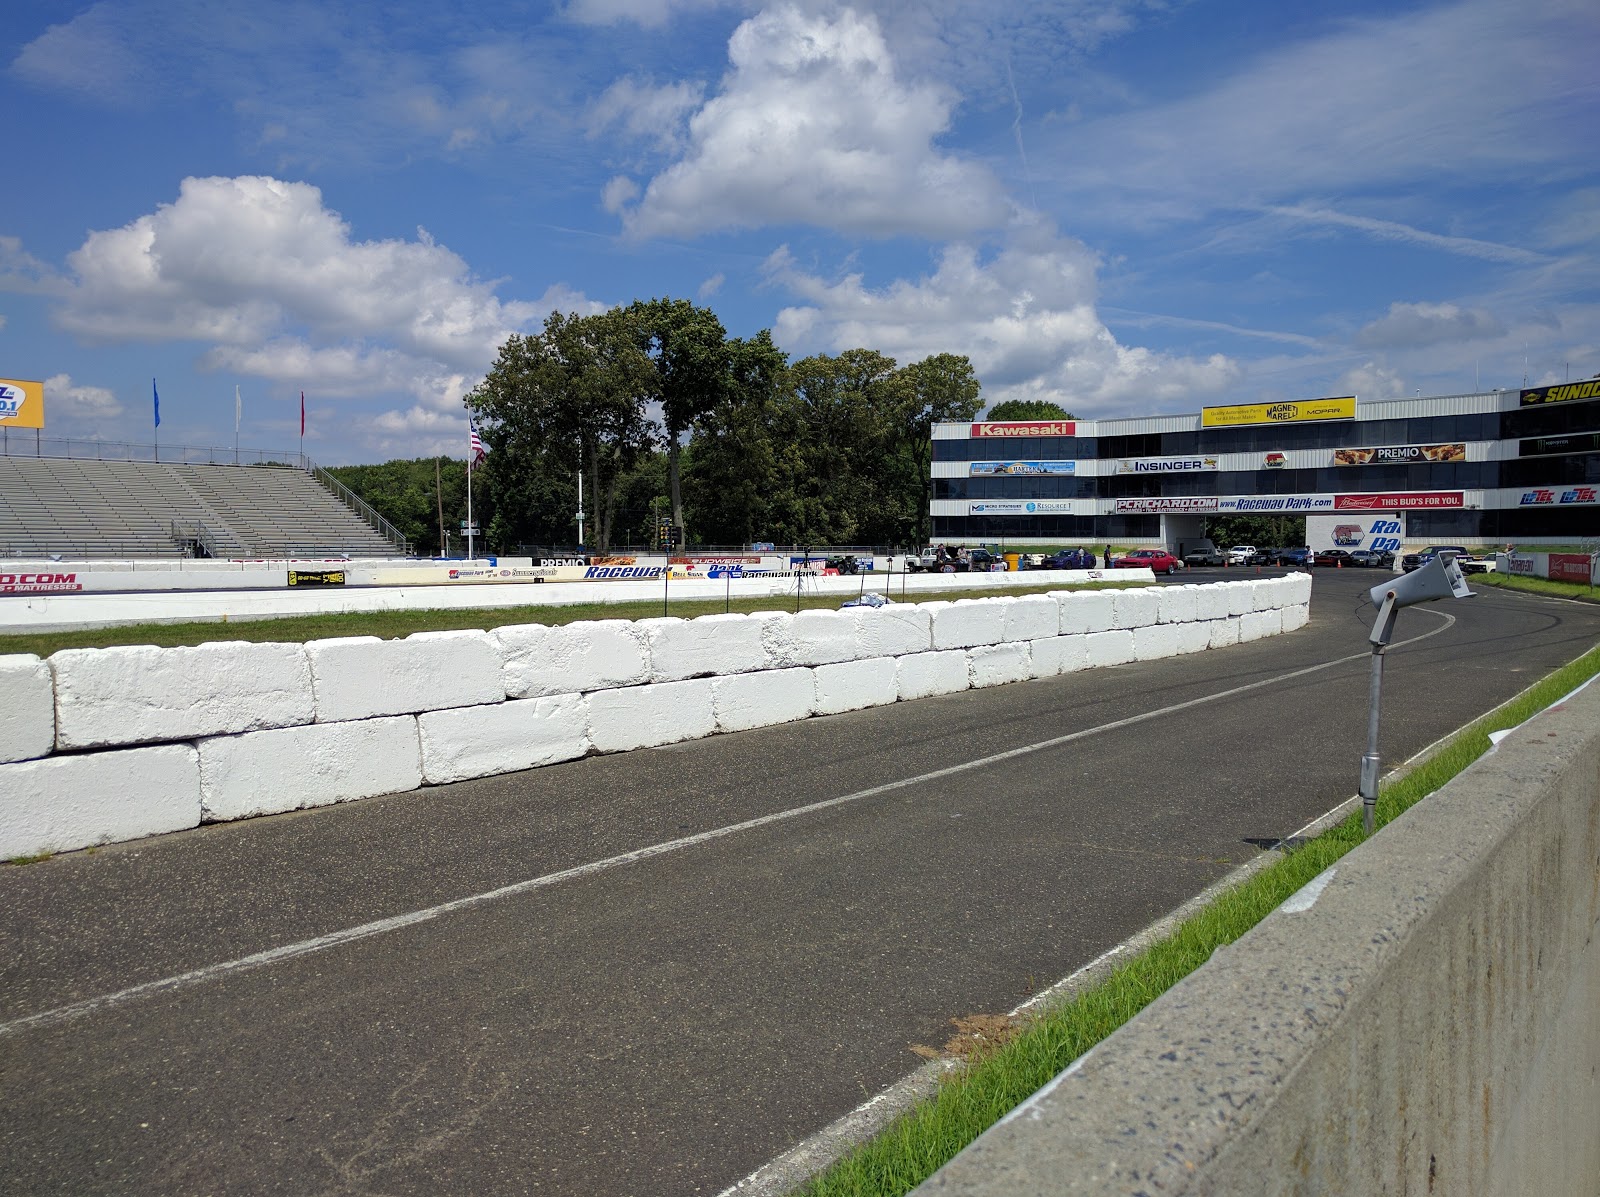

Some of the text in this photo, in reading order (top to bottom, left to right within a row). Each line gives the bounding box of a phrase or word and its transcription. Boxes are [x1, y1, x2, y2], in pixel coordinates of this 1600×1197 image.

[980, 423, 1067, 436] Kawasaki
[1378, 448, 1420, 458] PREMIO
[1135, 461, 1202, 471] INSINGER
[1381, 496, 1460, 506] THIS BUD'S FOR YOU.
[14, 584, 79, 592] MATTRESSES
